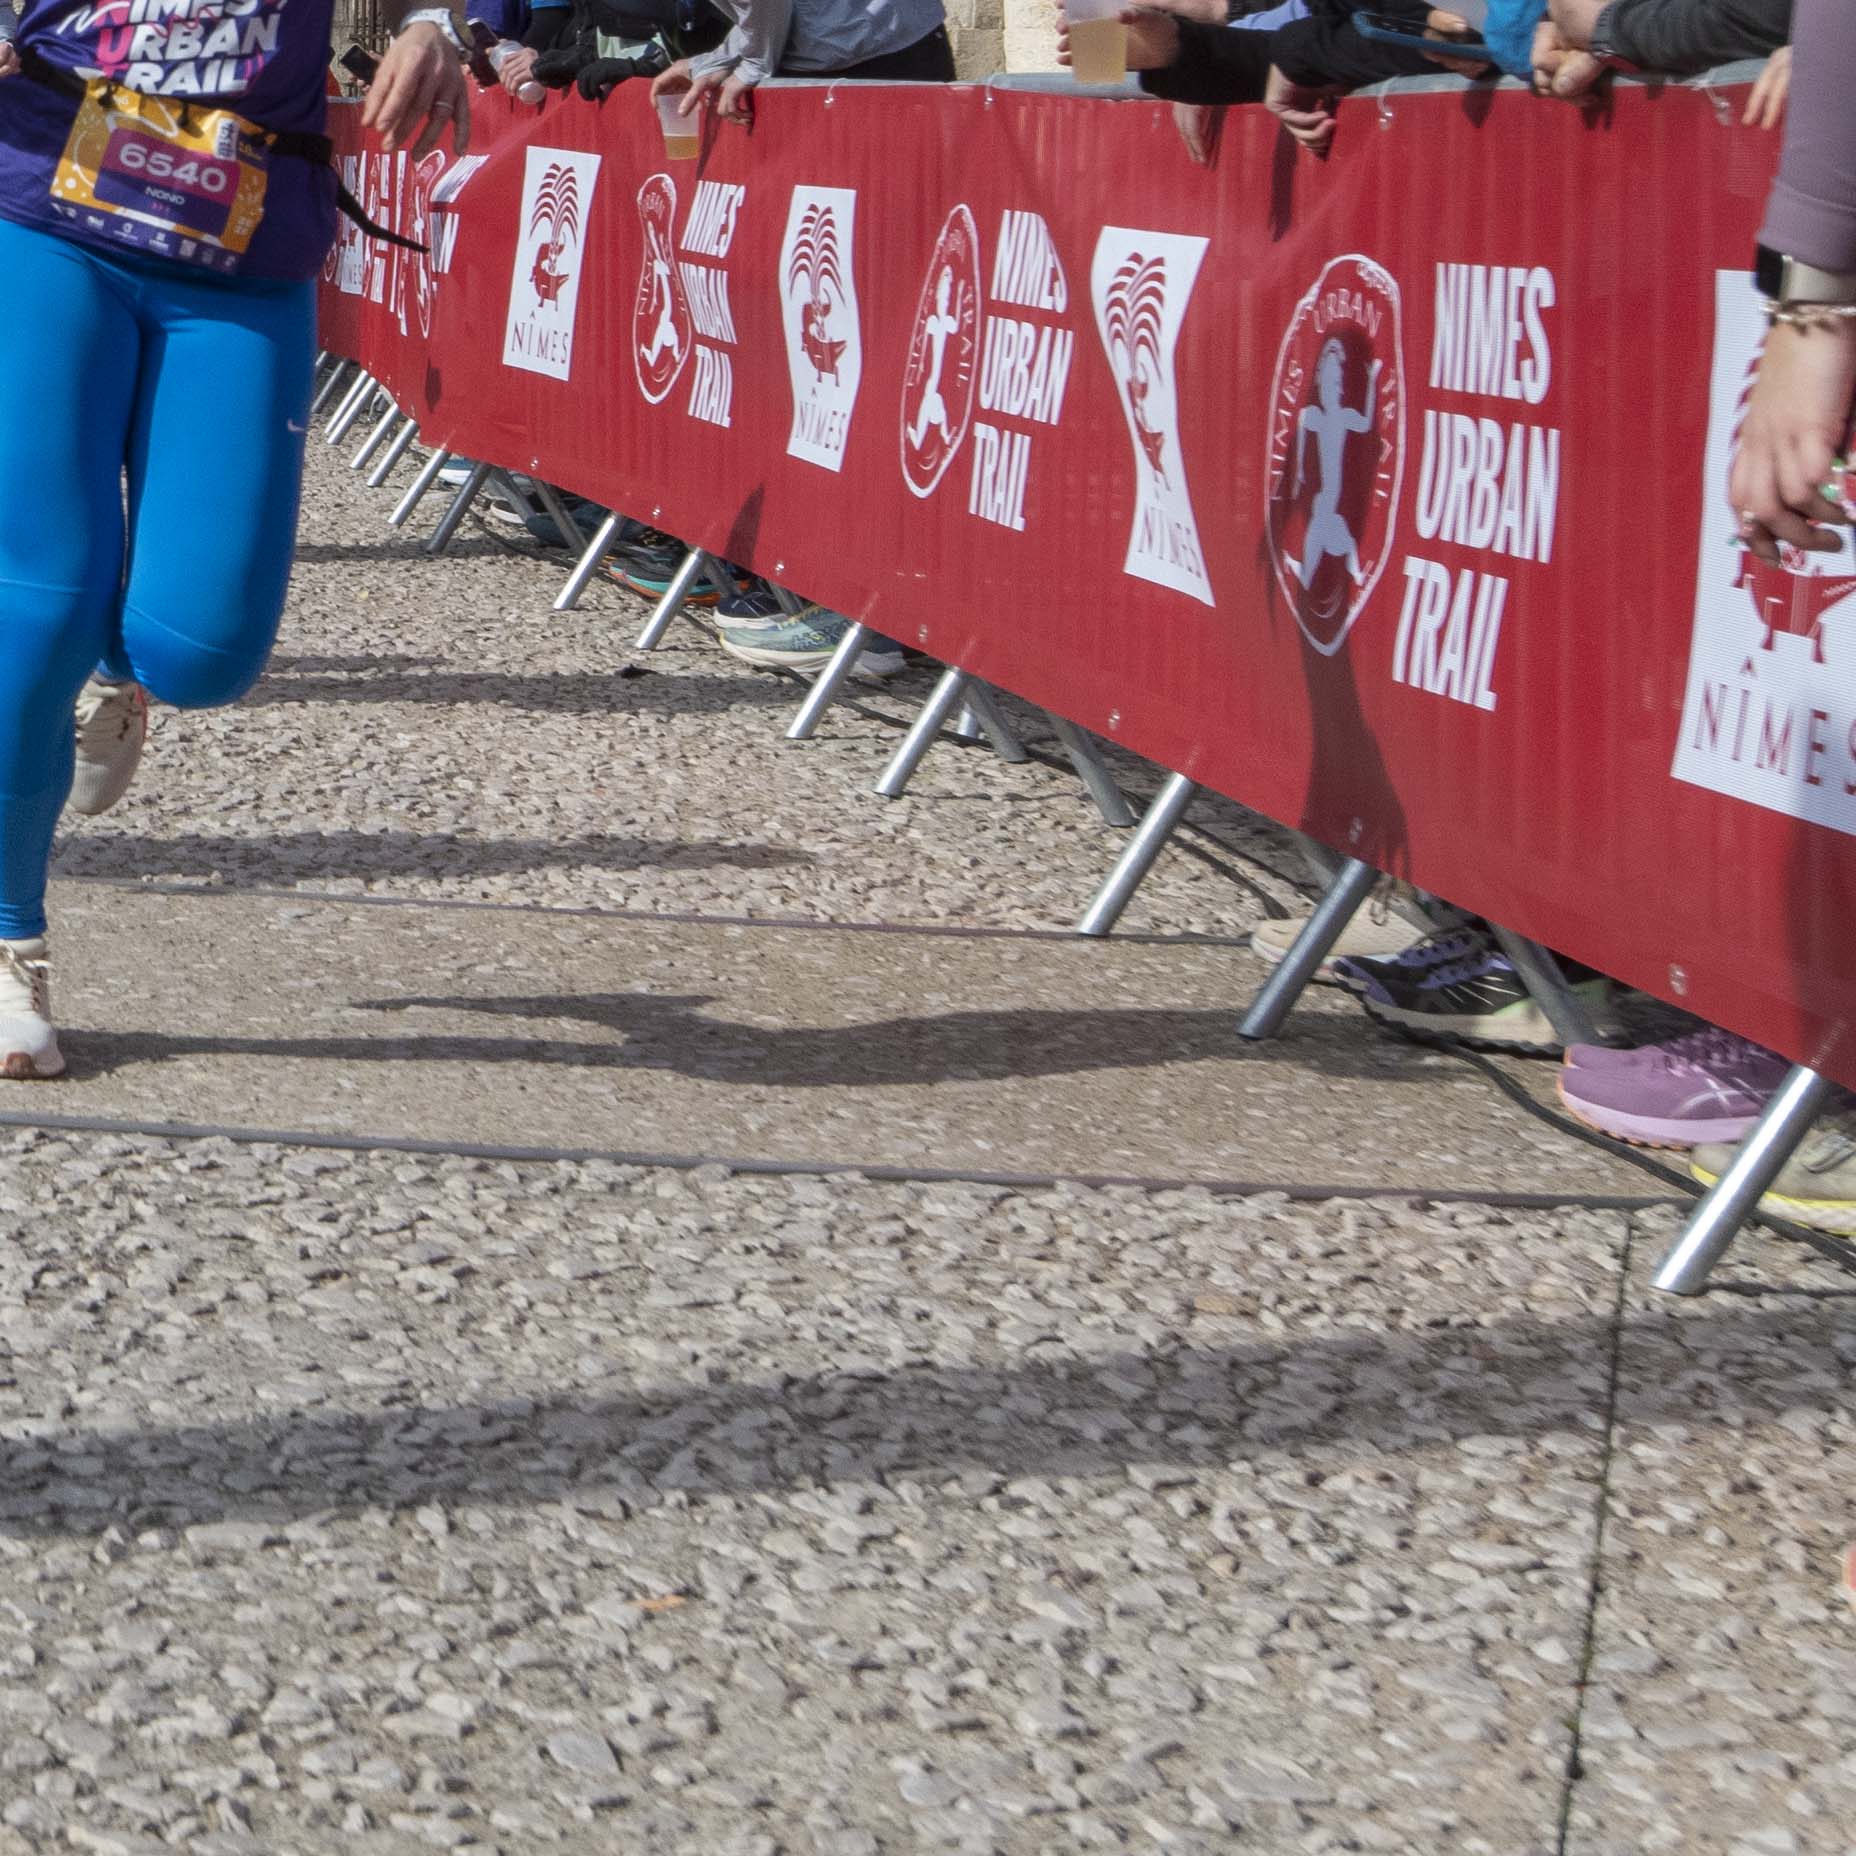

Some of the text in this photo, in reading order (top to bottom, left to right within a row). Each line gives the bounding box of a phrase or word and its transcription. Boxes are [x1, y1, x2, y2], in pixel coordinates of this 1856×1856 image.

[97, 14, 280, 63] URBAN
[119, 143, 227, 193] 6540
[144, 186, 186, 206] NONO
[680, 179, 747, 259] NIMES
[990, 209, 1069, 315] NIMES
[511, 310, 569, 364] NÎMES
[1313, 288, 1383, 338] URBAN
[1430, 262, 1556, 404] NIMES
[688, 344, 732, 428] TRAIL
[978, 315, 1074, 426] URBAN
[795, 387, 847, 453] NÎMES
[968, 422, 1032, 533] TRAIL
[1416, 409, 1561, 564] URBAN
[1392, 555, 1509, 712] TRAIL
